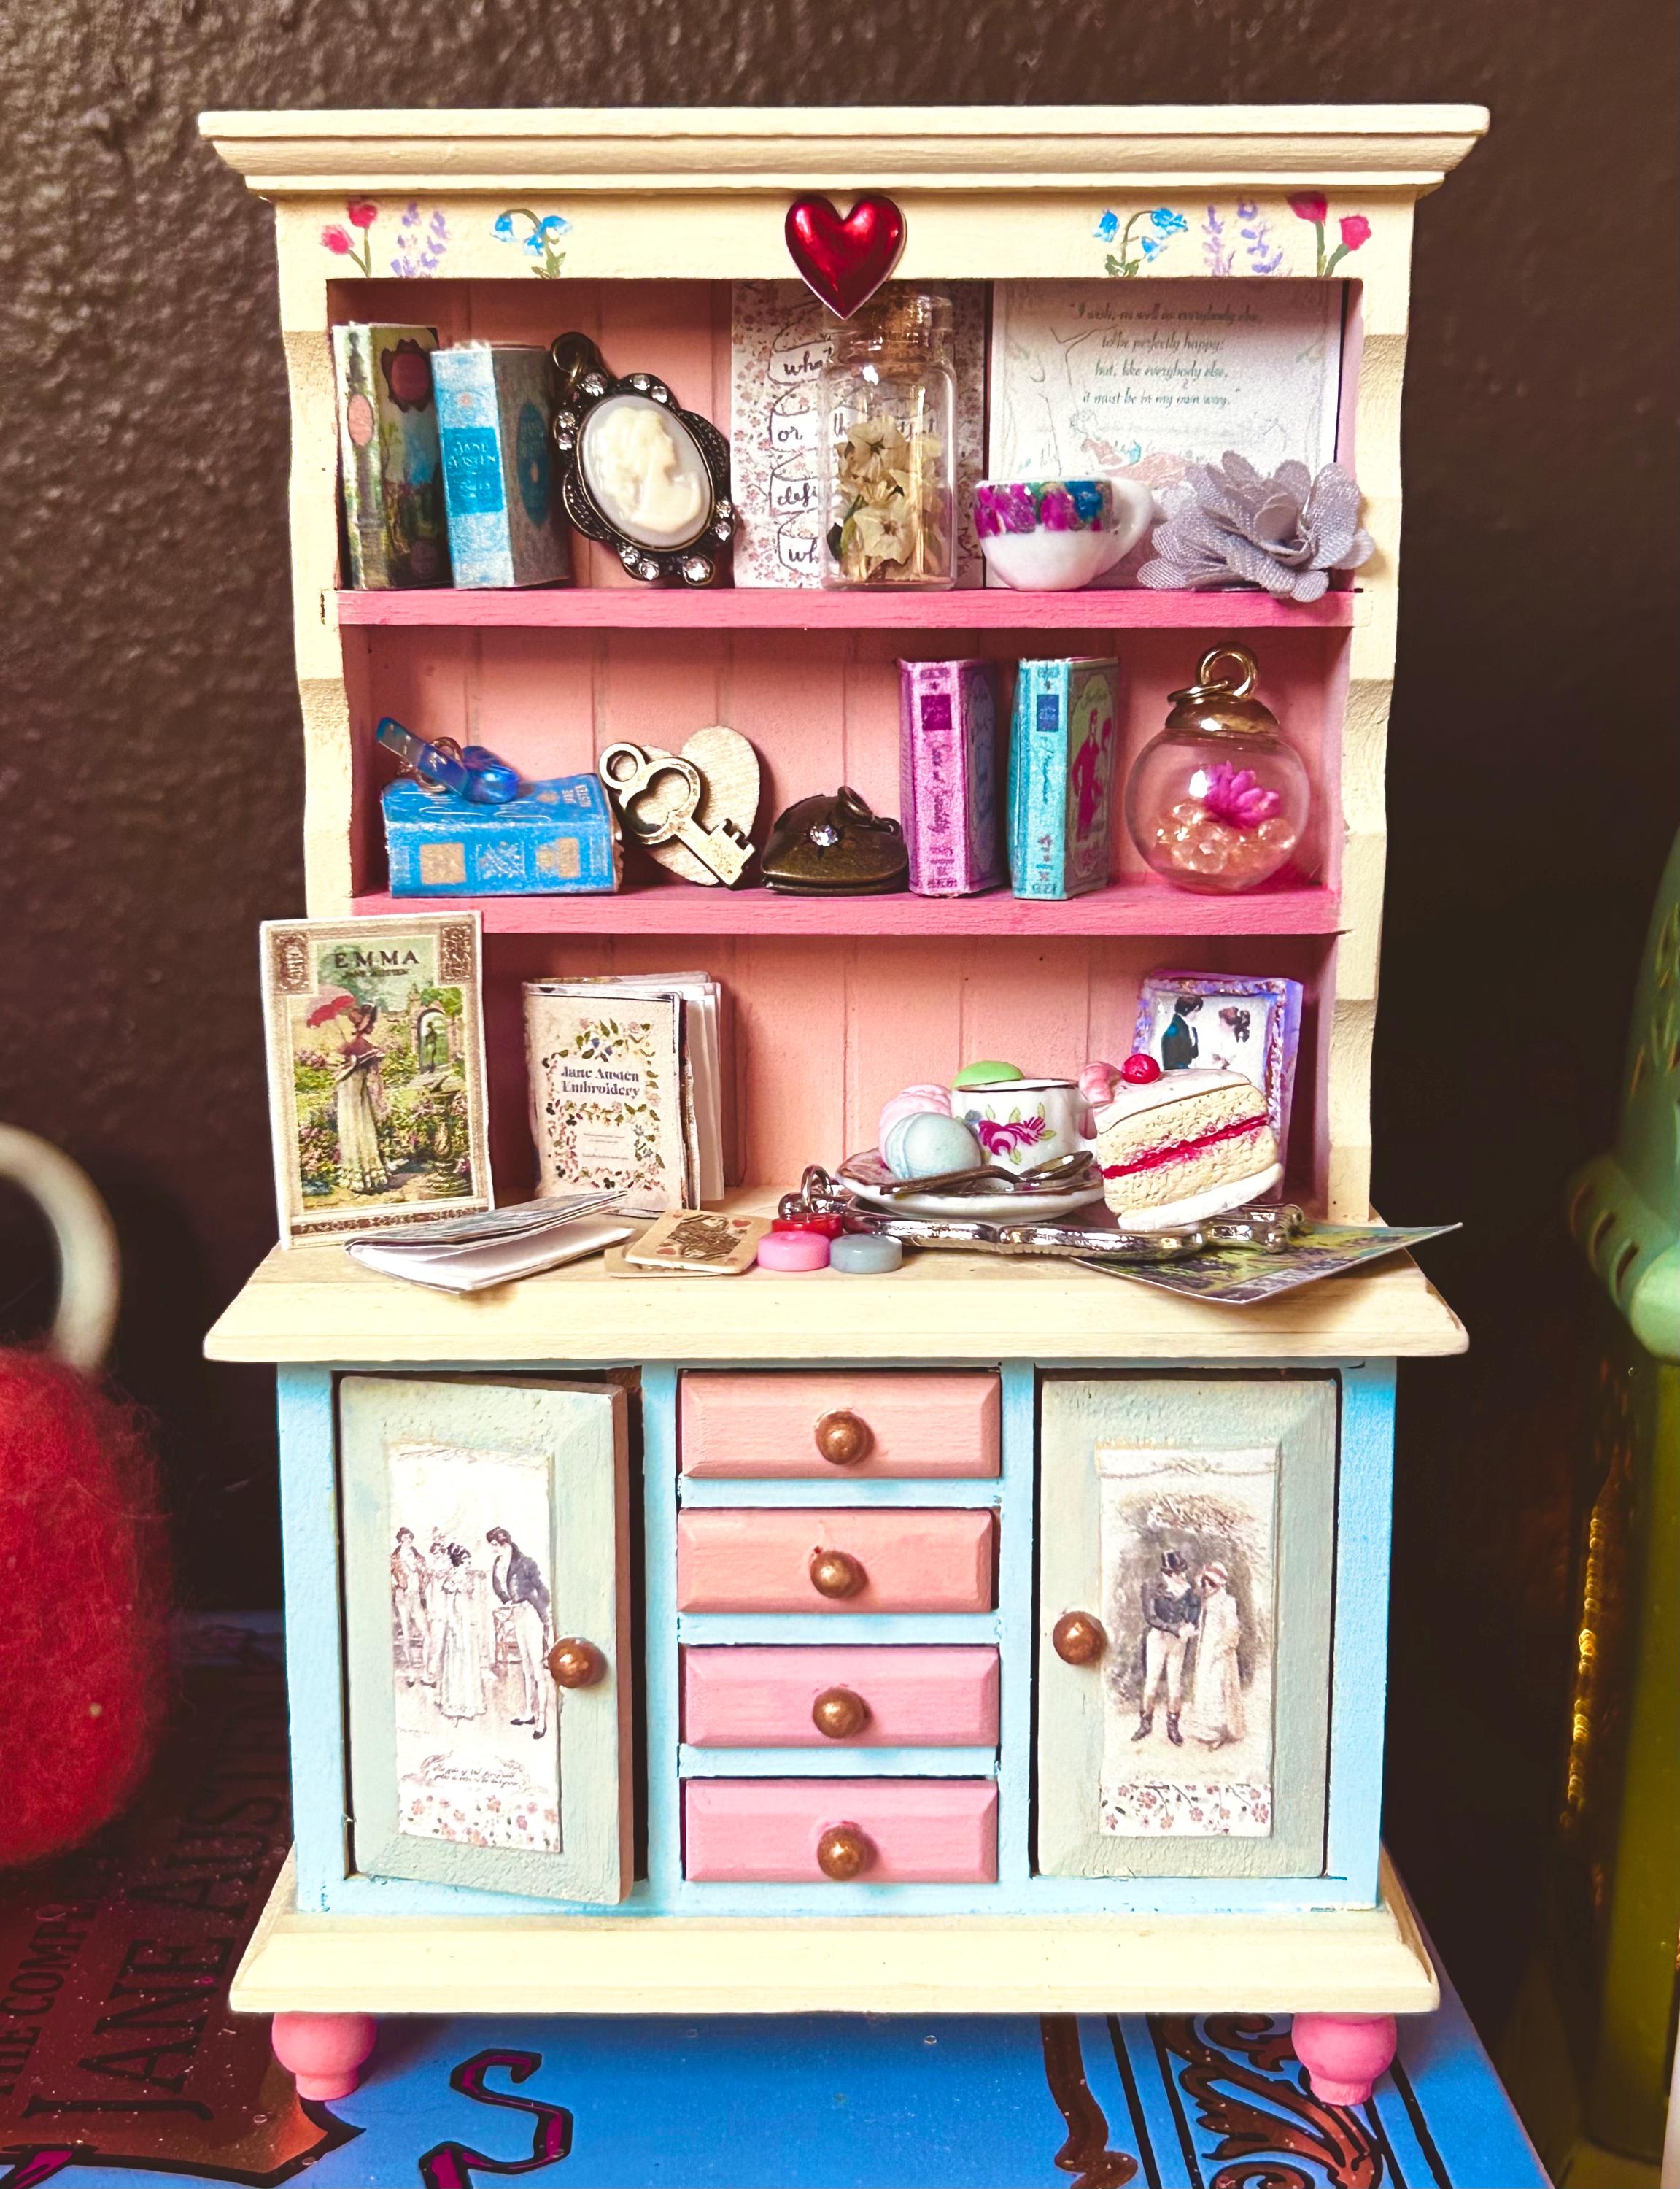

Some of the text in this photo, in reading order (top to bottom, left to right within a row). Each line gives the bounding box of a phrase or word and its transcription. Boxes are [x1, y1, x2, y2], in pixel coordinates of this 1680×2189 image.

[1132, 331, 1181, 353] perfectly
[1122, 358, 1140, 377] like
[1144, 358, 1201, 382] everybody
[1083, 392, 1091, 404] it
[1094, 392, 1121, 404] must
[1123, 387, 1135, 404] be
[1140, 391, 1153, 404] in
[1156, 395, 1174, 409] my
[1176, 395, 1199, 404] own
[778, 425, 803, 442] or
[777, 482, 818, 507] defi
[334, 949, 420, 969] EMMA
[560, 1066, 640, 1082] Jane Austen
[561, 1080, 640, 1100] Embroidery
[21, 1937, 236, 2122] JANE
